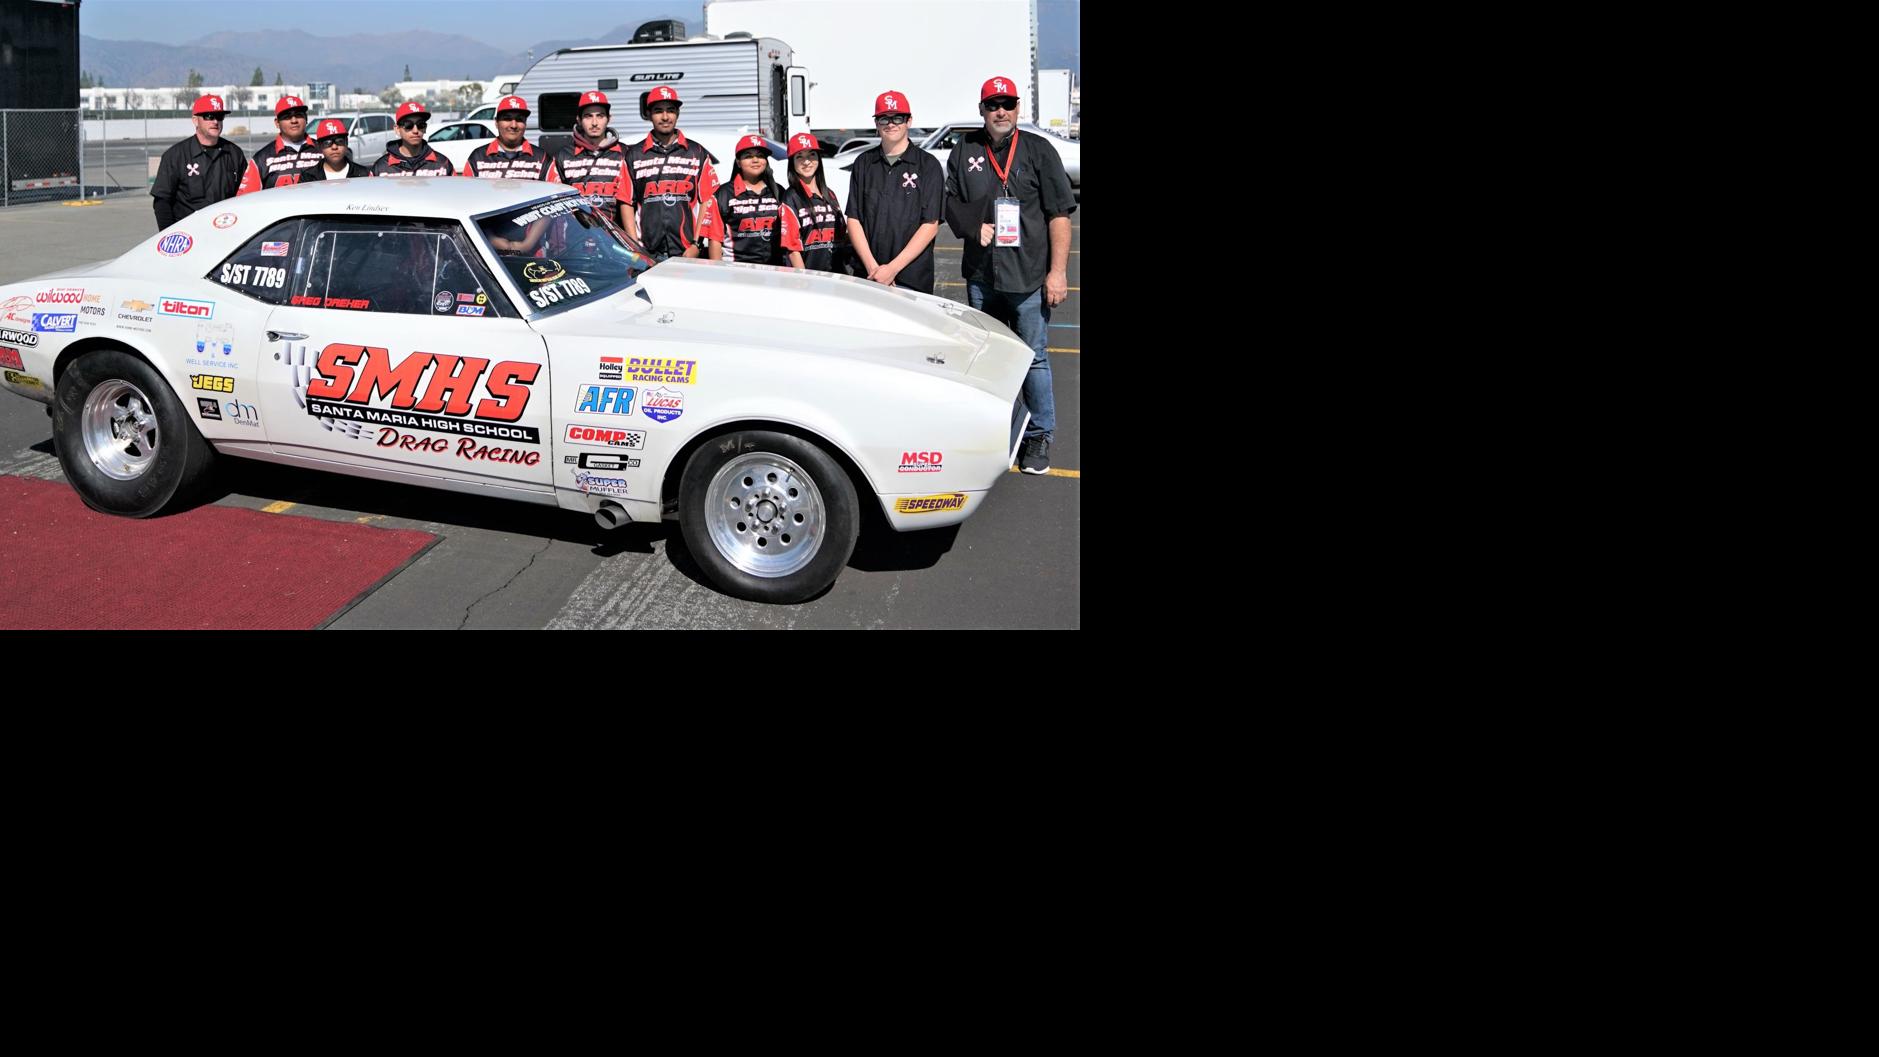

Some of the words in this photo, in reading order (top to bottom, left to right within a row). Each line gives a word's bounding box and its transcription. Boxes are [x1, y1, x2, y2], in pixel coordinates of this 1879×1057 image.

[633, 157, 666, 169] Santa
[636, 166, 660, 179] High
[662, 165, 700, 176] School
[644, 180, 694, 198] ARP
[758, 204, 779, 212] Sch
[738, 216, 777, 232] AR
[161, 234, 190, 253] NHRA
[221, 263, 251, 285] S/ST
[253, 266, 286, 288] 7789
[36, 288, 85, 304] wilwood
[529, 283, 564, 308] S/ST
[559, 277, 591, 297] 7789
[80, 306, 106, 316] MOTORS
[162, 300, 210, 316] tilton
[40, 314, 77, 327] CALVERT
[117, 313, 153, 323] CHEVROLET
[0, 329, 38, 345] RWOOD
[186, 358, 201, 366] WELL
[202, 360, 227, 369] SERVICE
[599, 362, 623, 373] Holley
[627, 357, 697, 376] BULLET
[192, 374, 235, 393] JEGS
[306, 342, 543, 424] SMHS
[632, 374, 663, 383] RACING
[666, 375, 690, 384] CAMS
[578, 386, 635, 415] AFR
[647, 397, 681, 408] LUCAS
[311, 403, 364, 420] SANTA
[366, 410, 418, 427] MARIA
[421, 417, 461, 432] HIGH
[463, 423, 534, 441] SCHOOL
[569, 427, 626, 442] COMP
[608, 440, 636, 448] CAMS
[901, 452, 943, 465] MSD
[586, 477, 628, 489] SUPER
[589, 486, 629, 494] MUFFLER
[907, 498, 964, 510] SPEEDWAY
